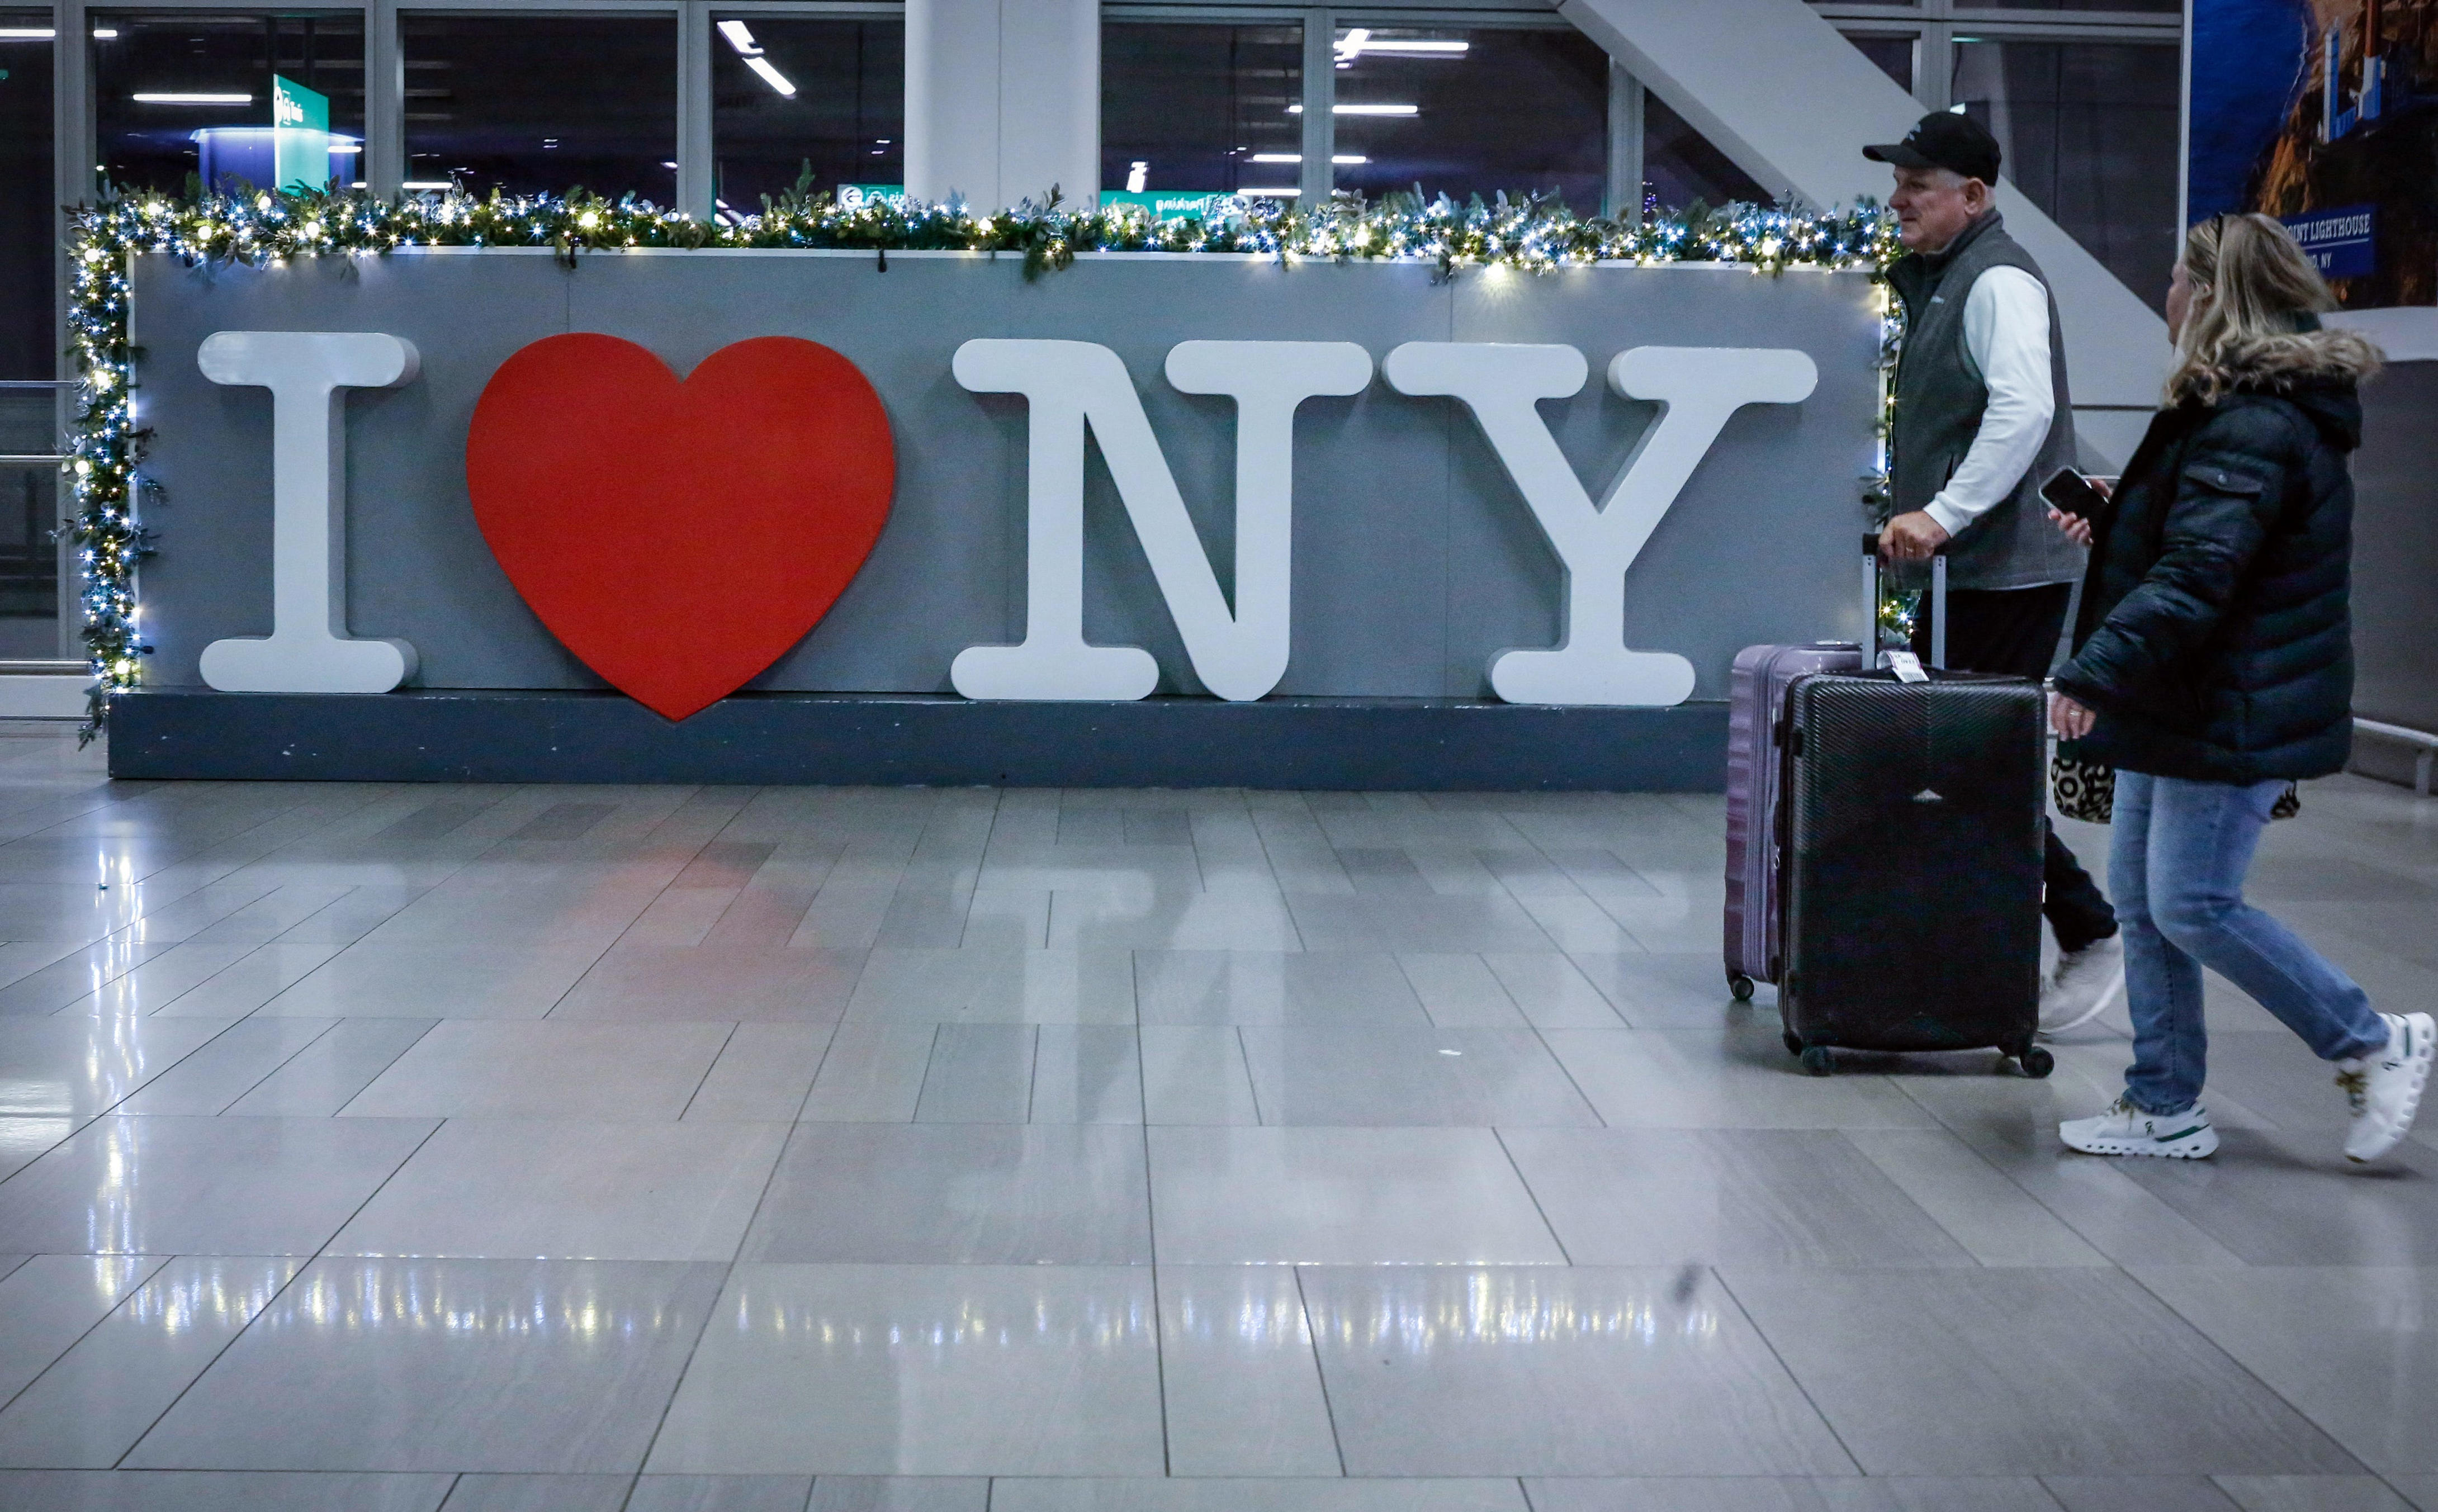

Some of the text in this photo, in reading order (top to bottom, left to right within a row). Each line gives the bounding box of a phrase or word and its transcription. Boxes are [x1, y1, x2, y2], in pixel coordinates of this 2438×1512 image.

[2310, 214, 2370, 241] LIGHTHOUSE
[2321, 252, 2332, 268] NY
[197, 331, 1818, 705] I NY
